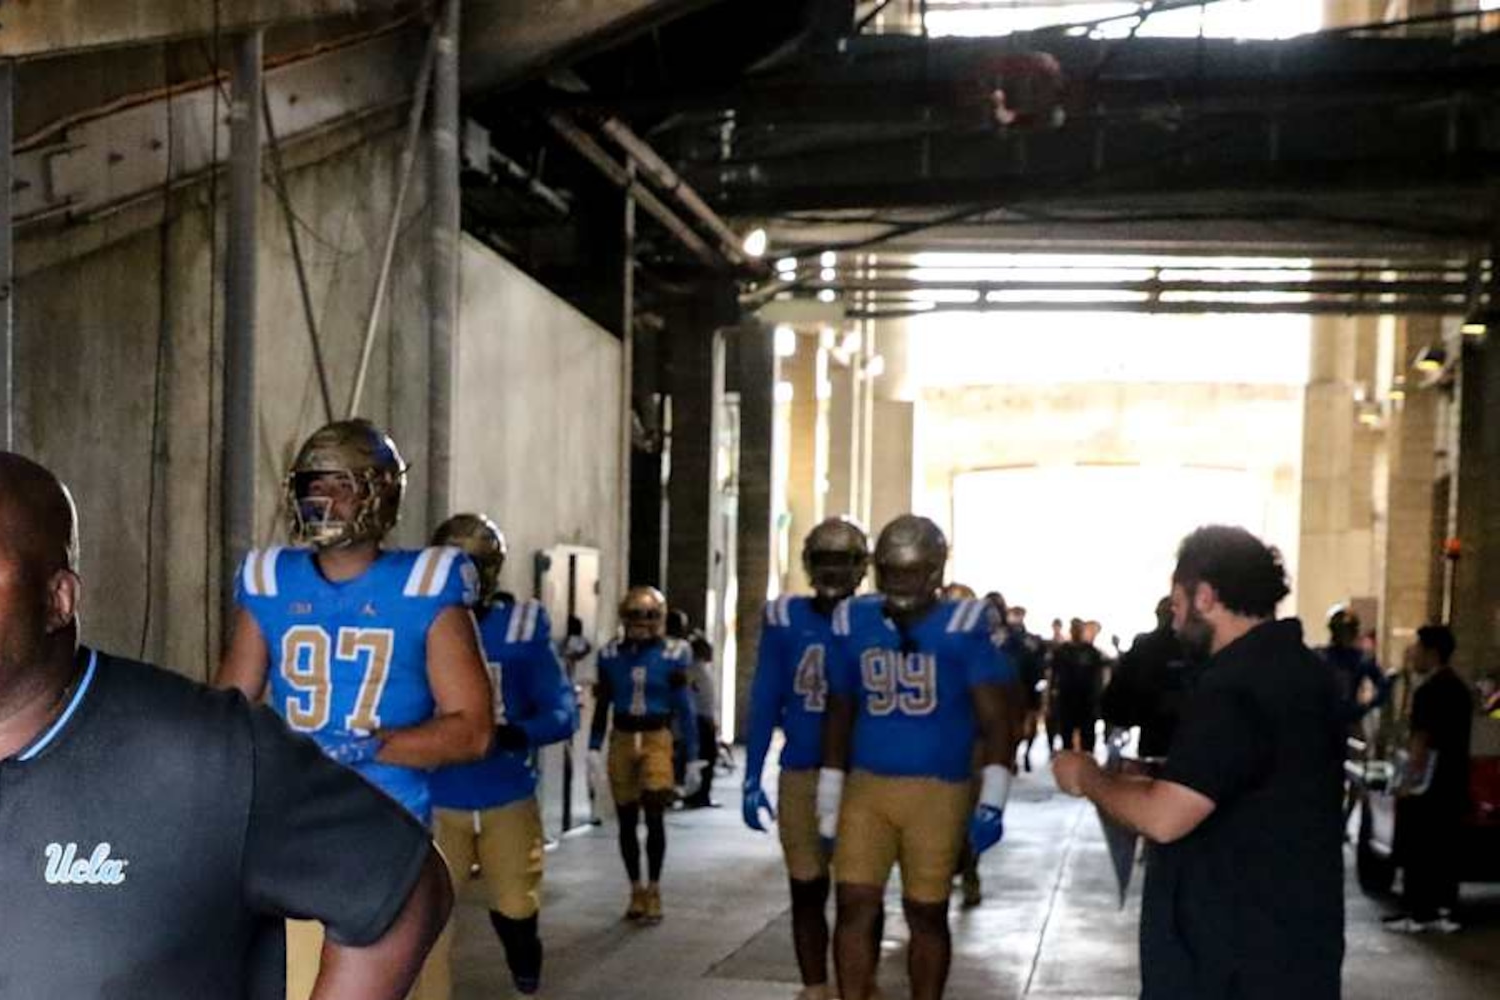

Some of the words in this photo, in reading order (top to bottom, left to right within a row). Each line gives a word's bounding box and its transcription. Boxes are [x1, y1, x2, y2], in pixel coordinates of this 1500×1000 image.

[280, 625, 394, 732] 97
[629, 666, 647, 716] 1
[793, 643, 828, 712] 4
[860, 648, 938, 716] 99
[45, 842, 127, 885] Ucla
